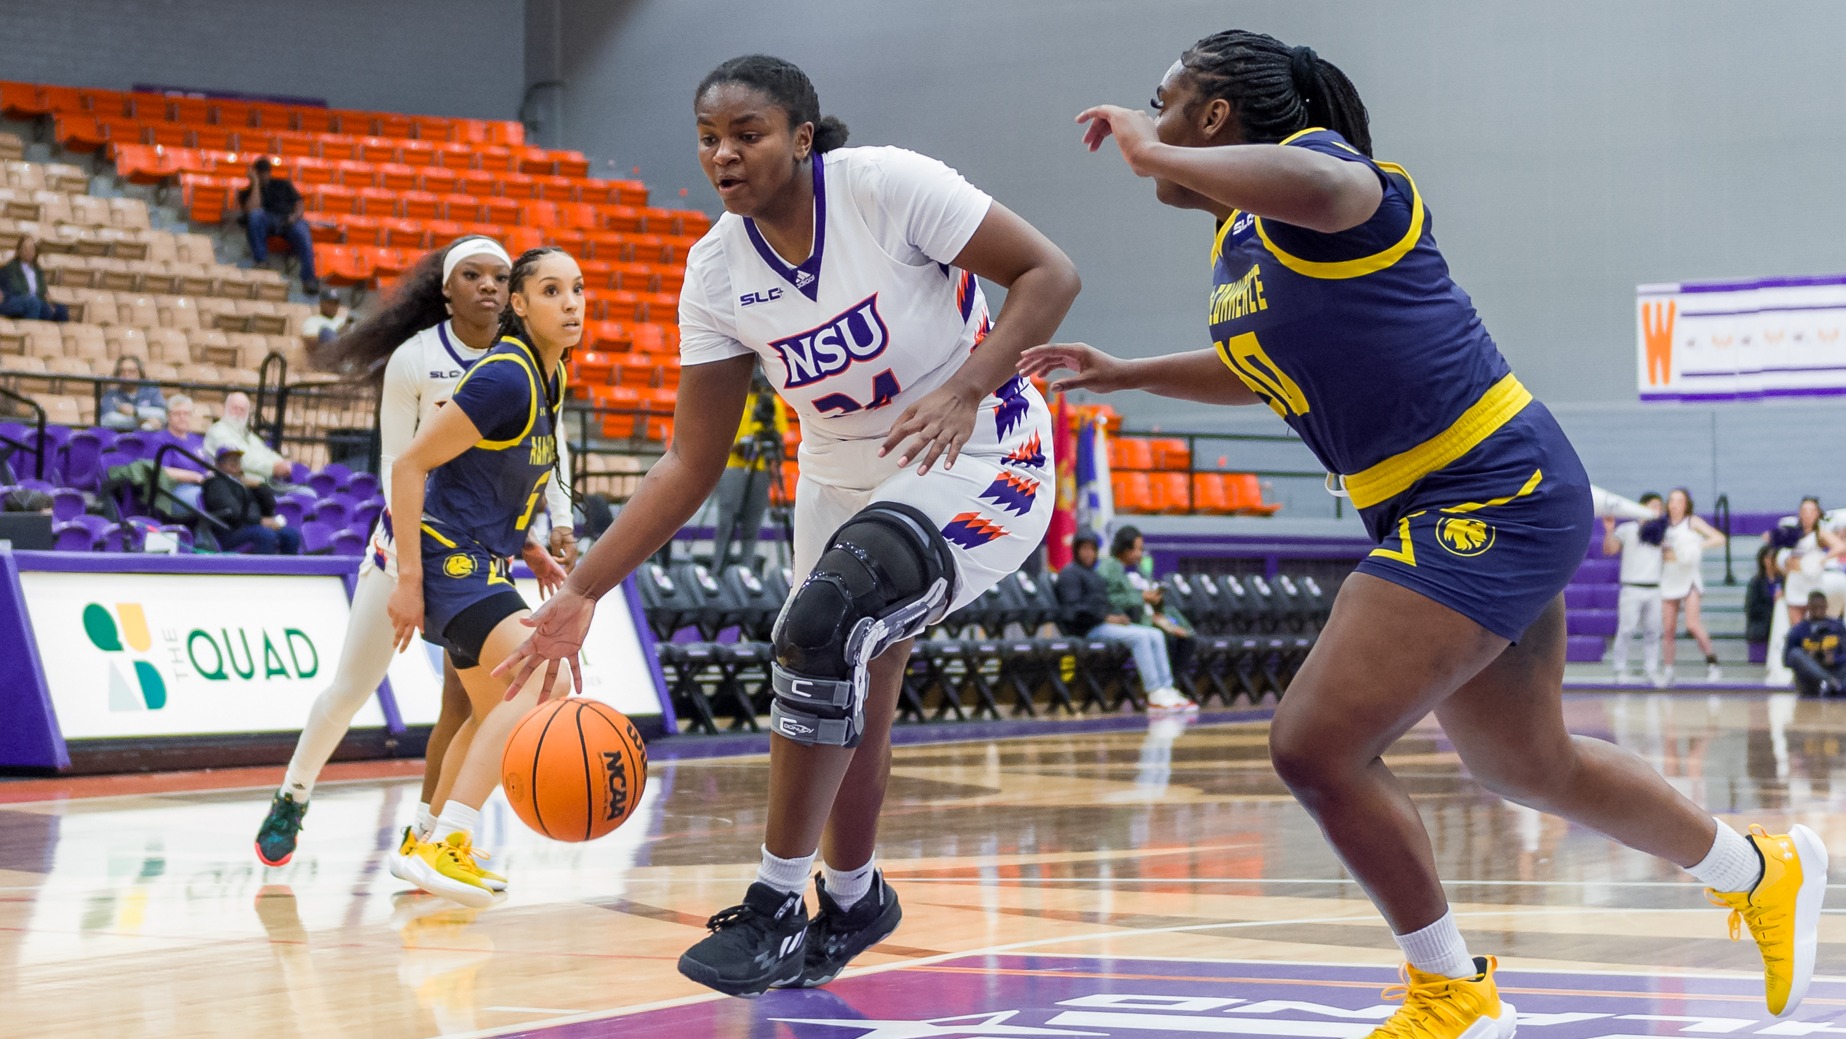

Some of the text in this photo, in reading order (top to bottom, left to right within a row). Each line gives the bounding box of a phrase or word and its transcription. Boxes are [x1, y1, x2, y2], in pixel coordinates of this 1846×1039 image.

[740, 287, 783, 306] SLC
[777, 302, 885, 385] NSU
[161, 627, 319, 682] THE QUAD
[604, 750, 627, 821] NCAA
